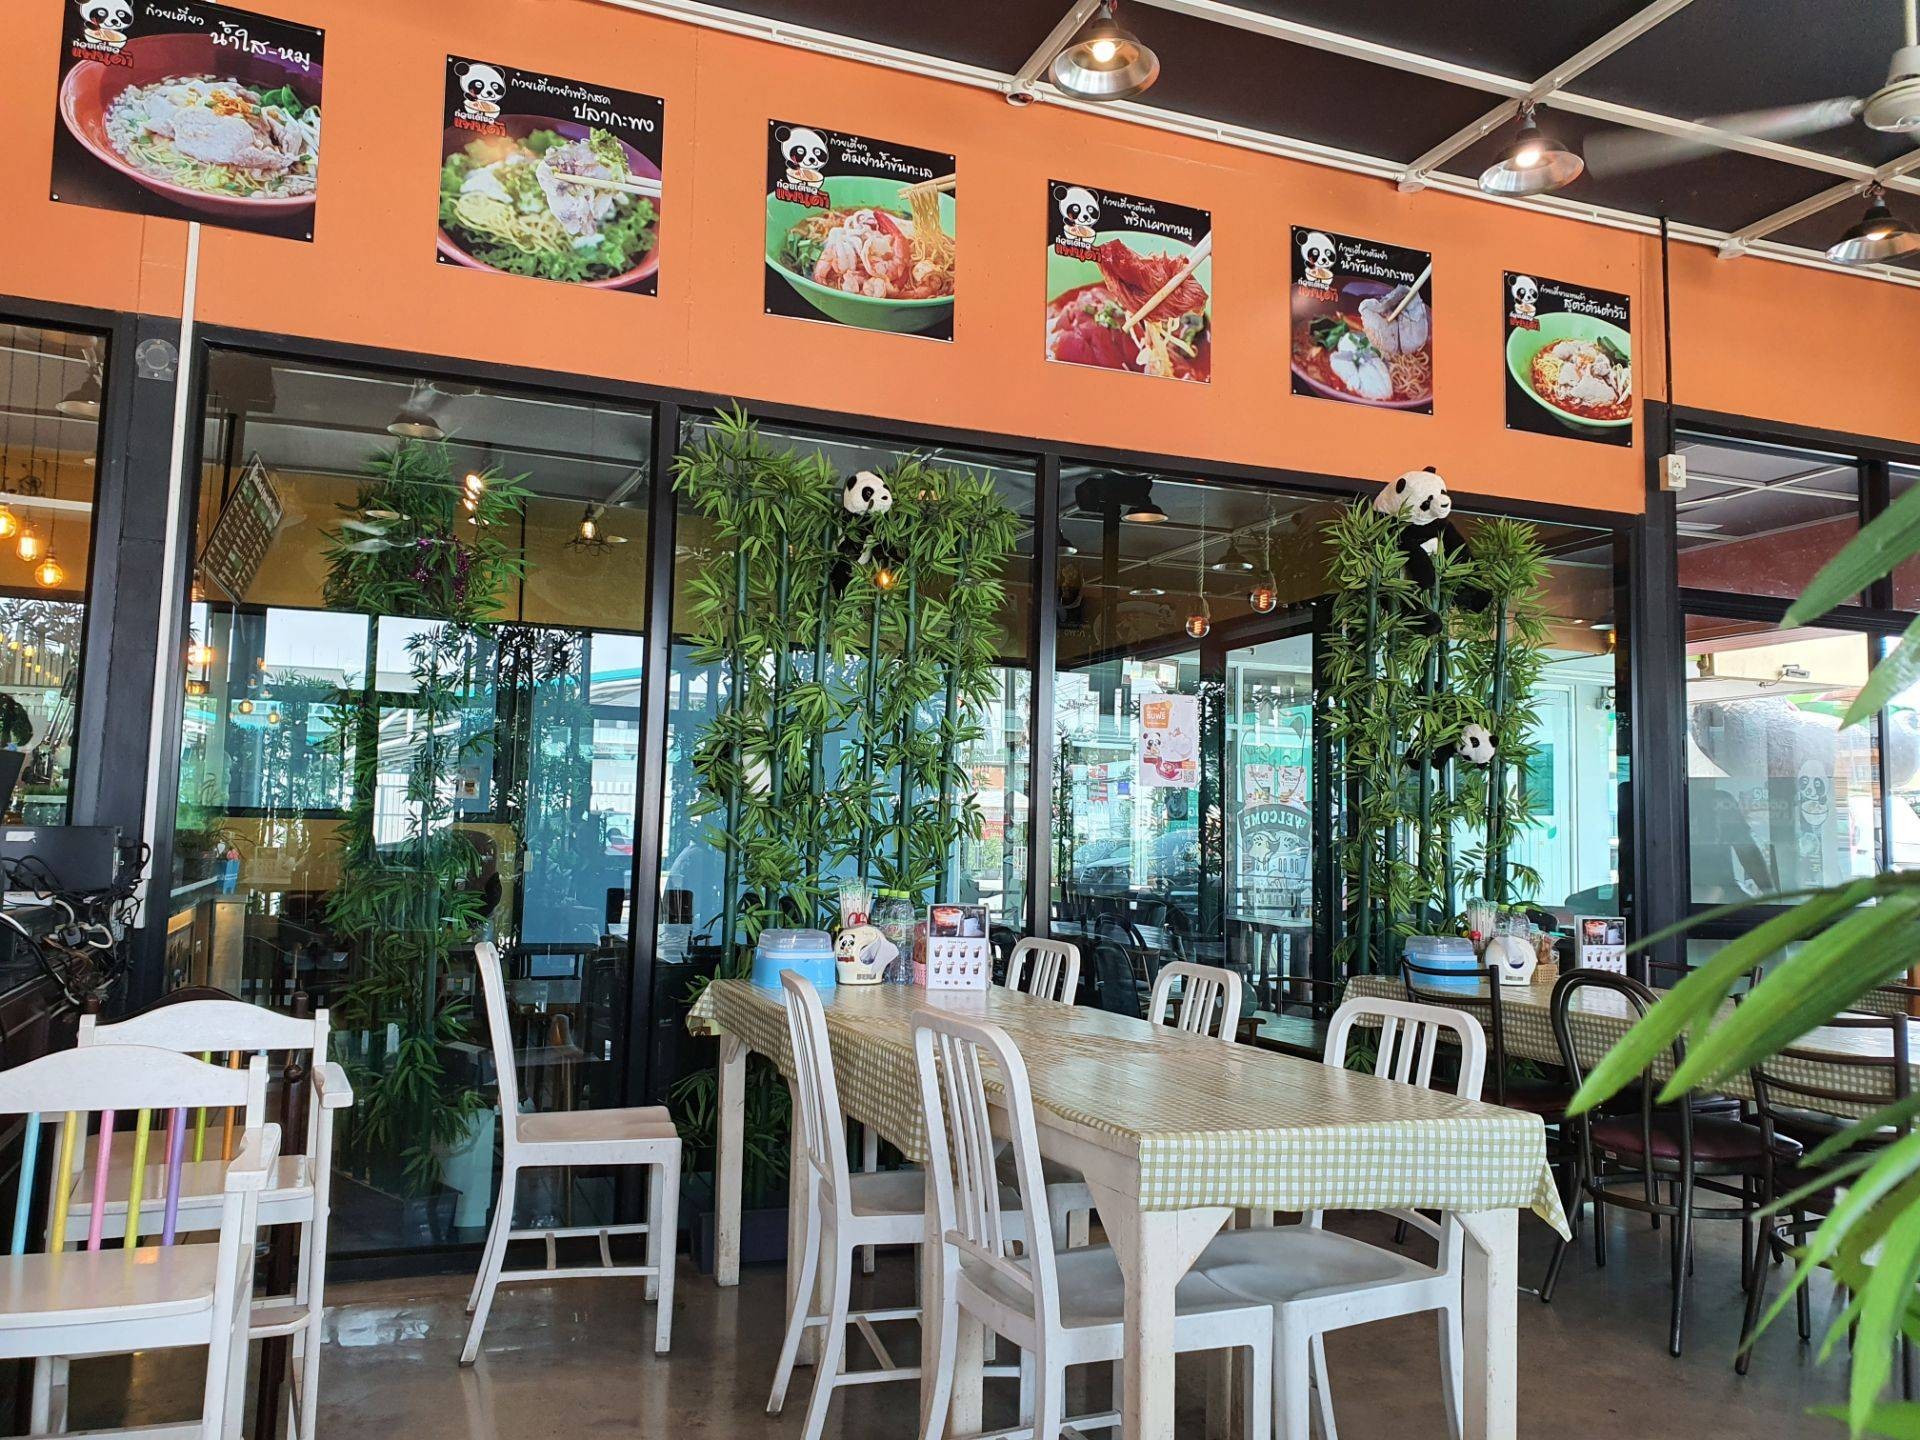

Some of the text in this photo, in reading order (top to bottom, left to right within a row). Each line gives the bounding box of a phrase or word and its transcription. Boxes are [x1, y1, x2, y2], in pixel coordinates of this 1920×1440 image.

[573, 103, 655, 132] ปลากะพง
[841, 149, 933, 179] ต้มยำน้ำข้นทะเล
[1340, 253, 1415, 282] น้ำข้นปลากะพง
[1563, 298, 1627, 320] สูตรต้นตำรับ
